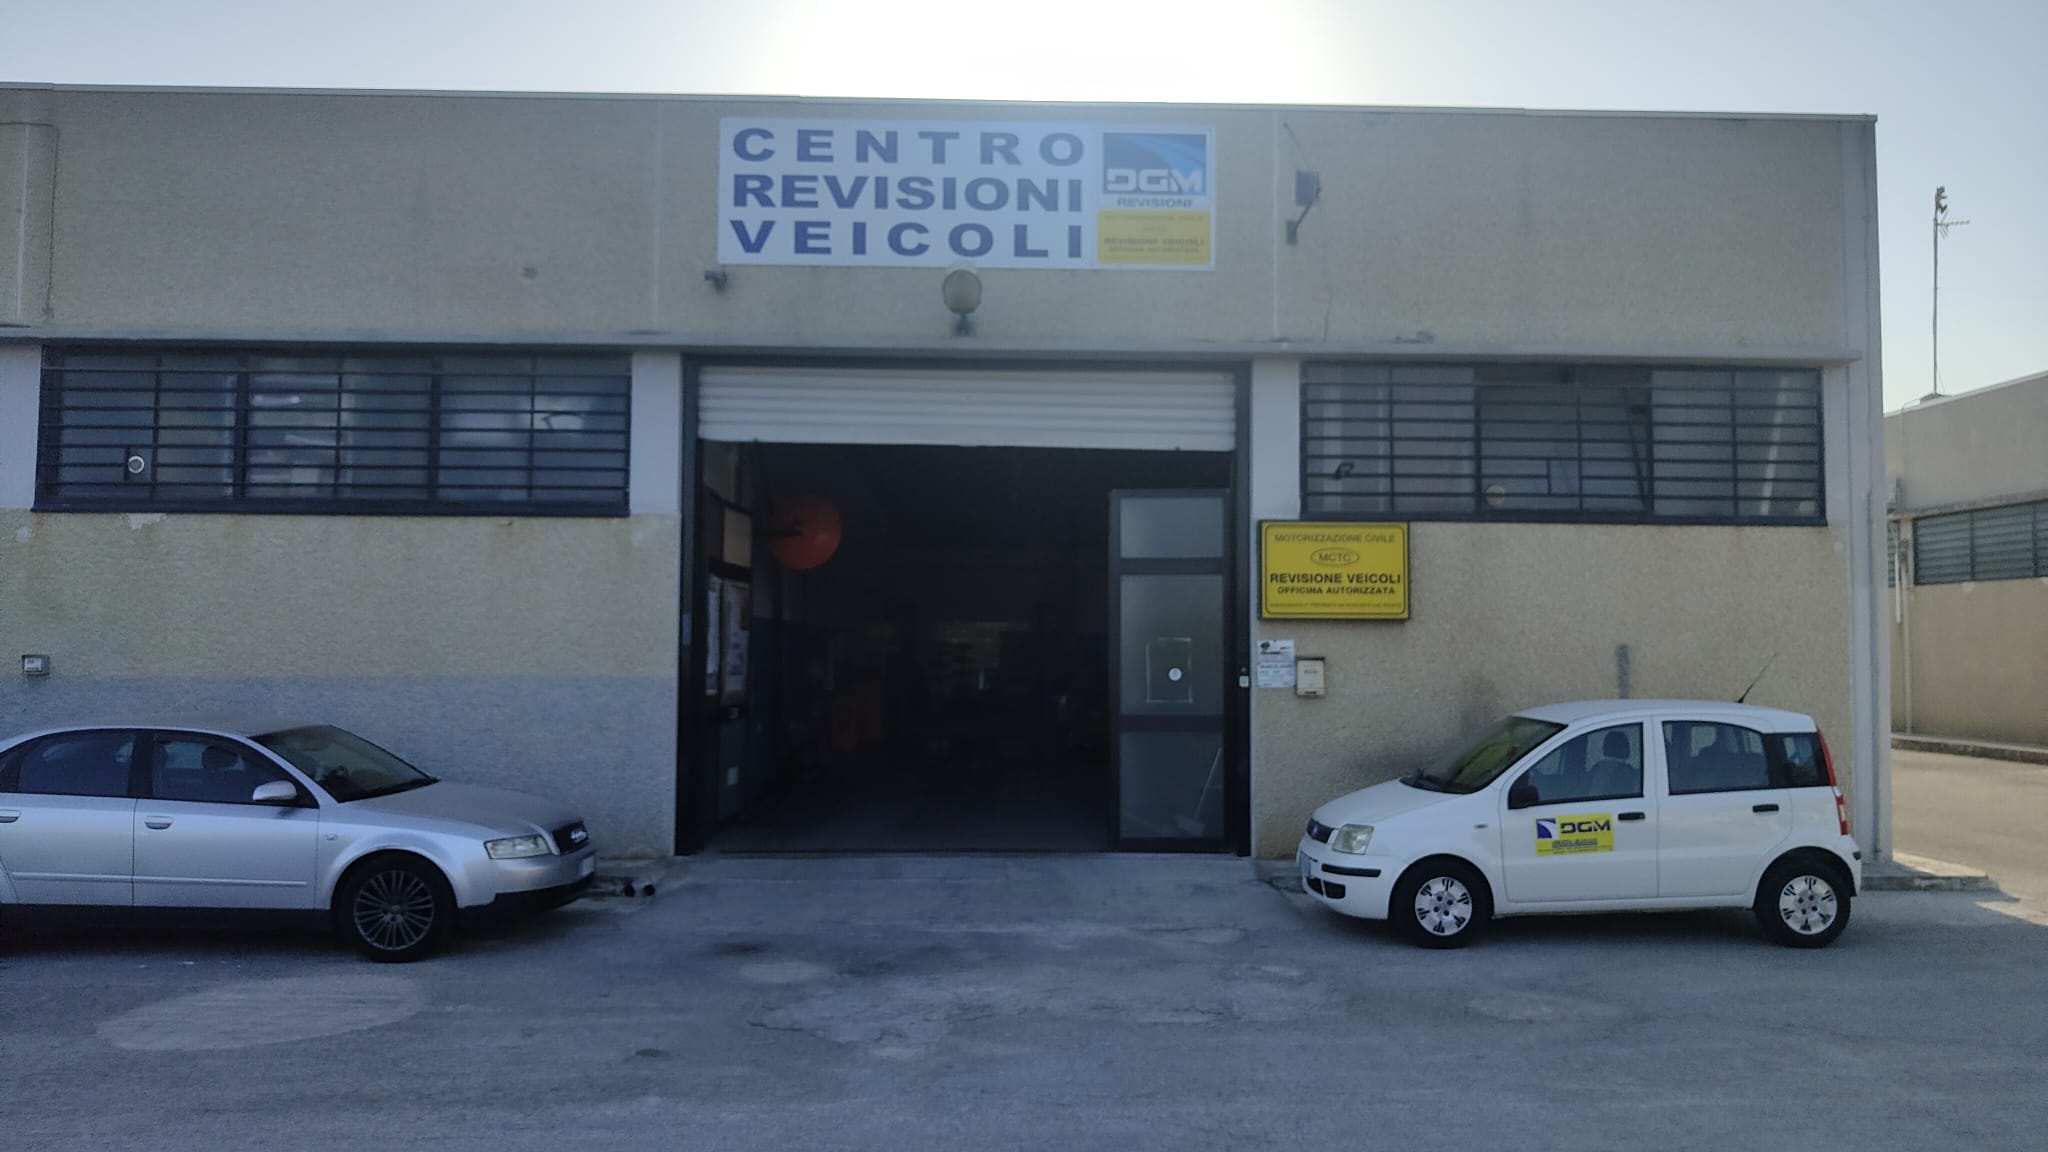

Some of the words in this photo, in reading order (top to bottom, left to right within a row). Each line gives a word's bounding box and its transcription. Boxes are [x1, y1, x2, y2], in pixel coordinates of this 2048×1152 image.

[732, 128, 1085, 167] CENTRO
[1106, 169, 1203, 193] DGM
[732, 174, 1083, 213] REVISIONI
[1116, 197, 1193, 209] REVISIONI
[729, 219, 1083, 259] VEICOLI
[1274, 534, 1362, 543] MOTORIZZAZIONE
[1365, 534, 1396, 543] CIVILE
[1318, 552, 1351, 562] MCTC
[1269, 572, 1343, 584] REVISIONE
[1347, 572, 1402, 585] VEICOLI
[1277, 586, 1323, 595] OFFICINA
[1326, 586, 1396, 595] AUTORIZZATA
[1559, 819, 1611, 834] DGM
